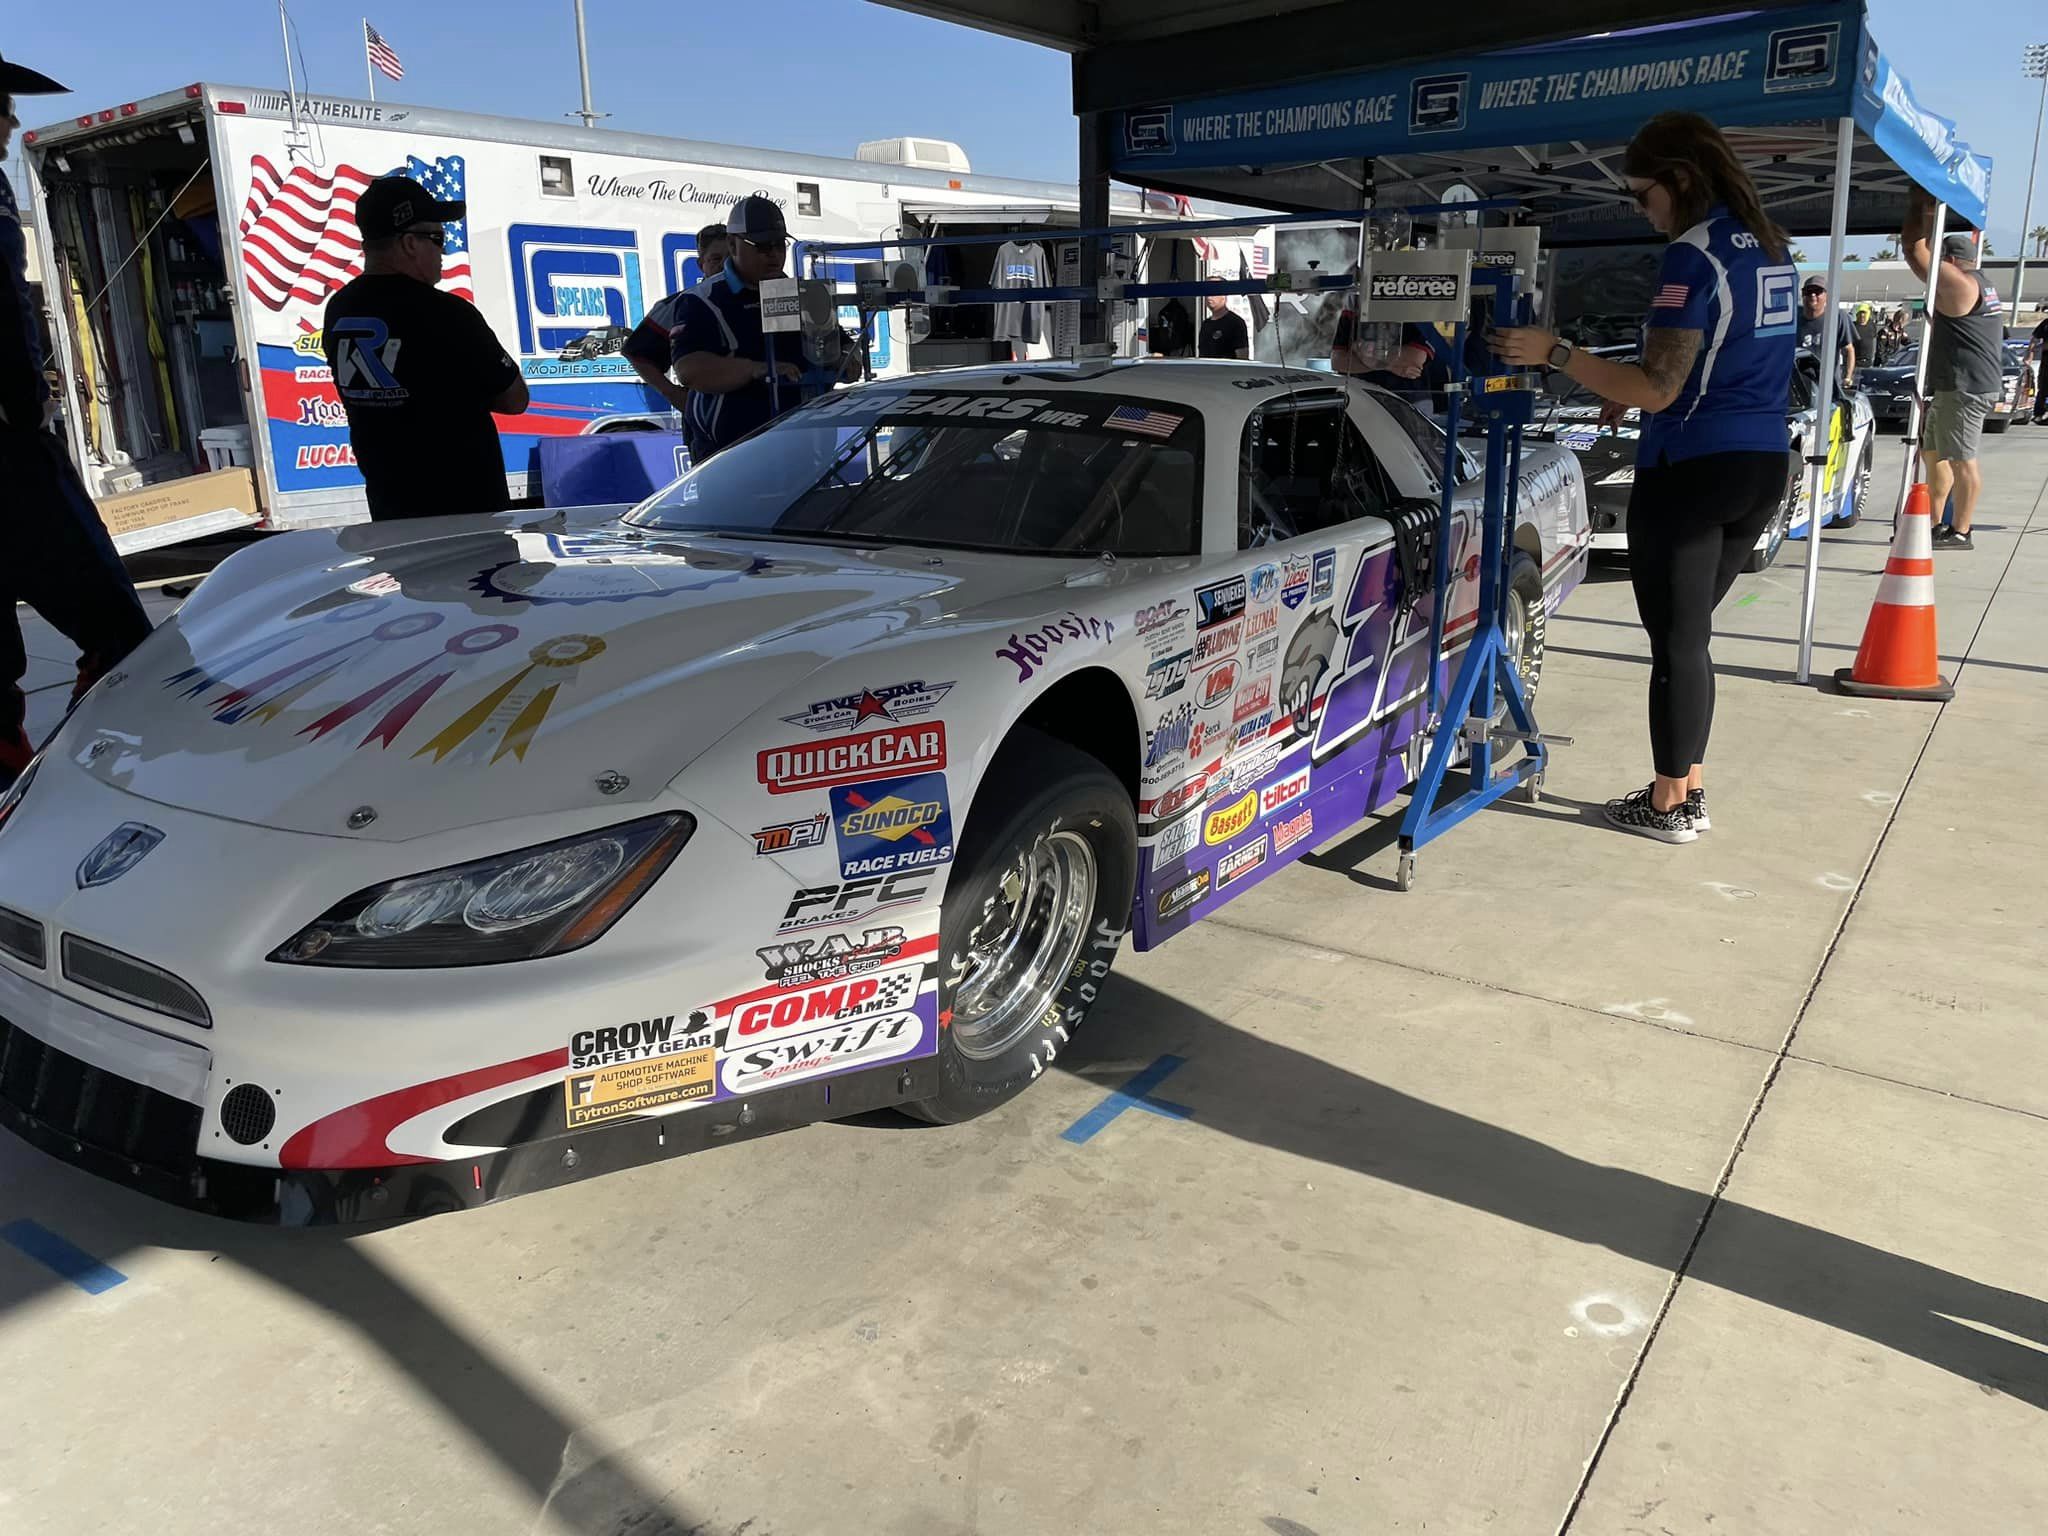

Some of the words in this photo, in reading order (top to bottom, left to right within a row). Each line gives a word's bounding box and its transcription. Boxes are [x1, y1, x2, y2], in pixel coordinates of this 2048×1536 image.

[1479, 80, 1538, 110] WHERE
[1544, 74, 1578, 102] THE
[1581, 58, 1694, 98] CHAMPIONS
[1698, 49, 1749, 83] RACE
[1183, 114, 1231, 142] WHERE
[1235, 111, 1261, 138] THE
[1266, 100, 1350, 136] CHAMPIONS
[1354, 94, 1397, 125] RACE
[588, 175, 645, 198] Where
[649, 180, 676, 200] The
[557, 286, 604, 316] SPEARS
[1373, 277, 1456, 296] referee
[528, 364, 589, 375] MODIFIED
[808, 396, 1052, 421] SPEARS
[996, 612, 1115, 683] Hoosier
[811, 695, 861, 715] FIVE
[872, 681, 925, 697] STAR
[893, 695, 931, 707] BODIES
[803, 714, 832, 724] STOCK
[834, 710, 851, 719] CAR
[1264, 774, 1306, 810] tilton
[849, 804, 937, 833] SUNOCO
[1210, 800, 1253, 836] Bassett
[1273, 808, 1313, 844] Magnus
[844, 856, 895, 875] RACE
[898, 845, 951, 866] FUELS
[784, 867, 937, 919] PFC
[779, 909, 859, 929] BRAKES
[783, 956, 841, 976] SHOCKS
[738, 979, 879, 1035] COMP
[835, 996, 899, 1020] CAMS
[572, 1016, 675, 1056] CROW
[572, 1045, 654, 1069] SAFETY
[659, 1034, 711, 1053] GEAR
[600, 1064, 664, 1083] AUTOMOTIVE
[666, 1054, 708, 1069] MACHINE
[616, 1078, 643, 1090] SHOP
[646, 1066, 696, 1085] SOFTWARE
[761, 1055, 834, 1079] springs
[575, 1084, 708, 1121] FytronSoftware.com
